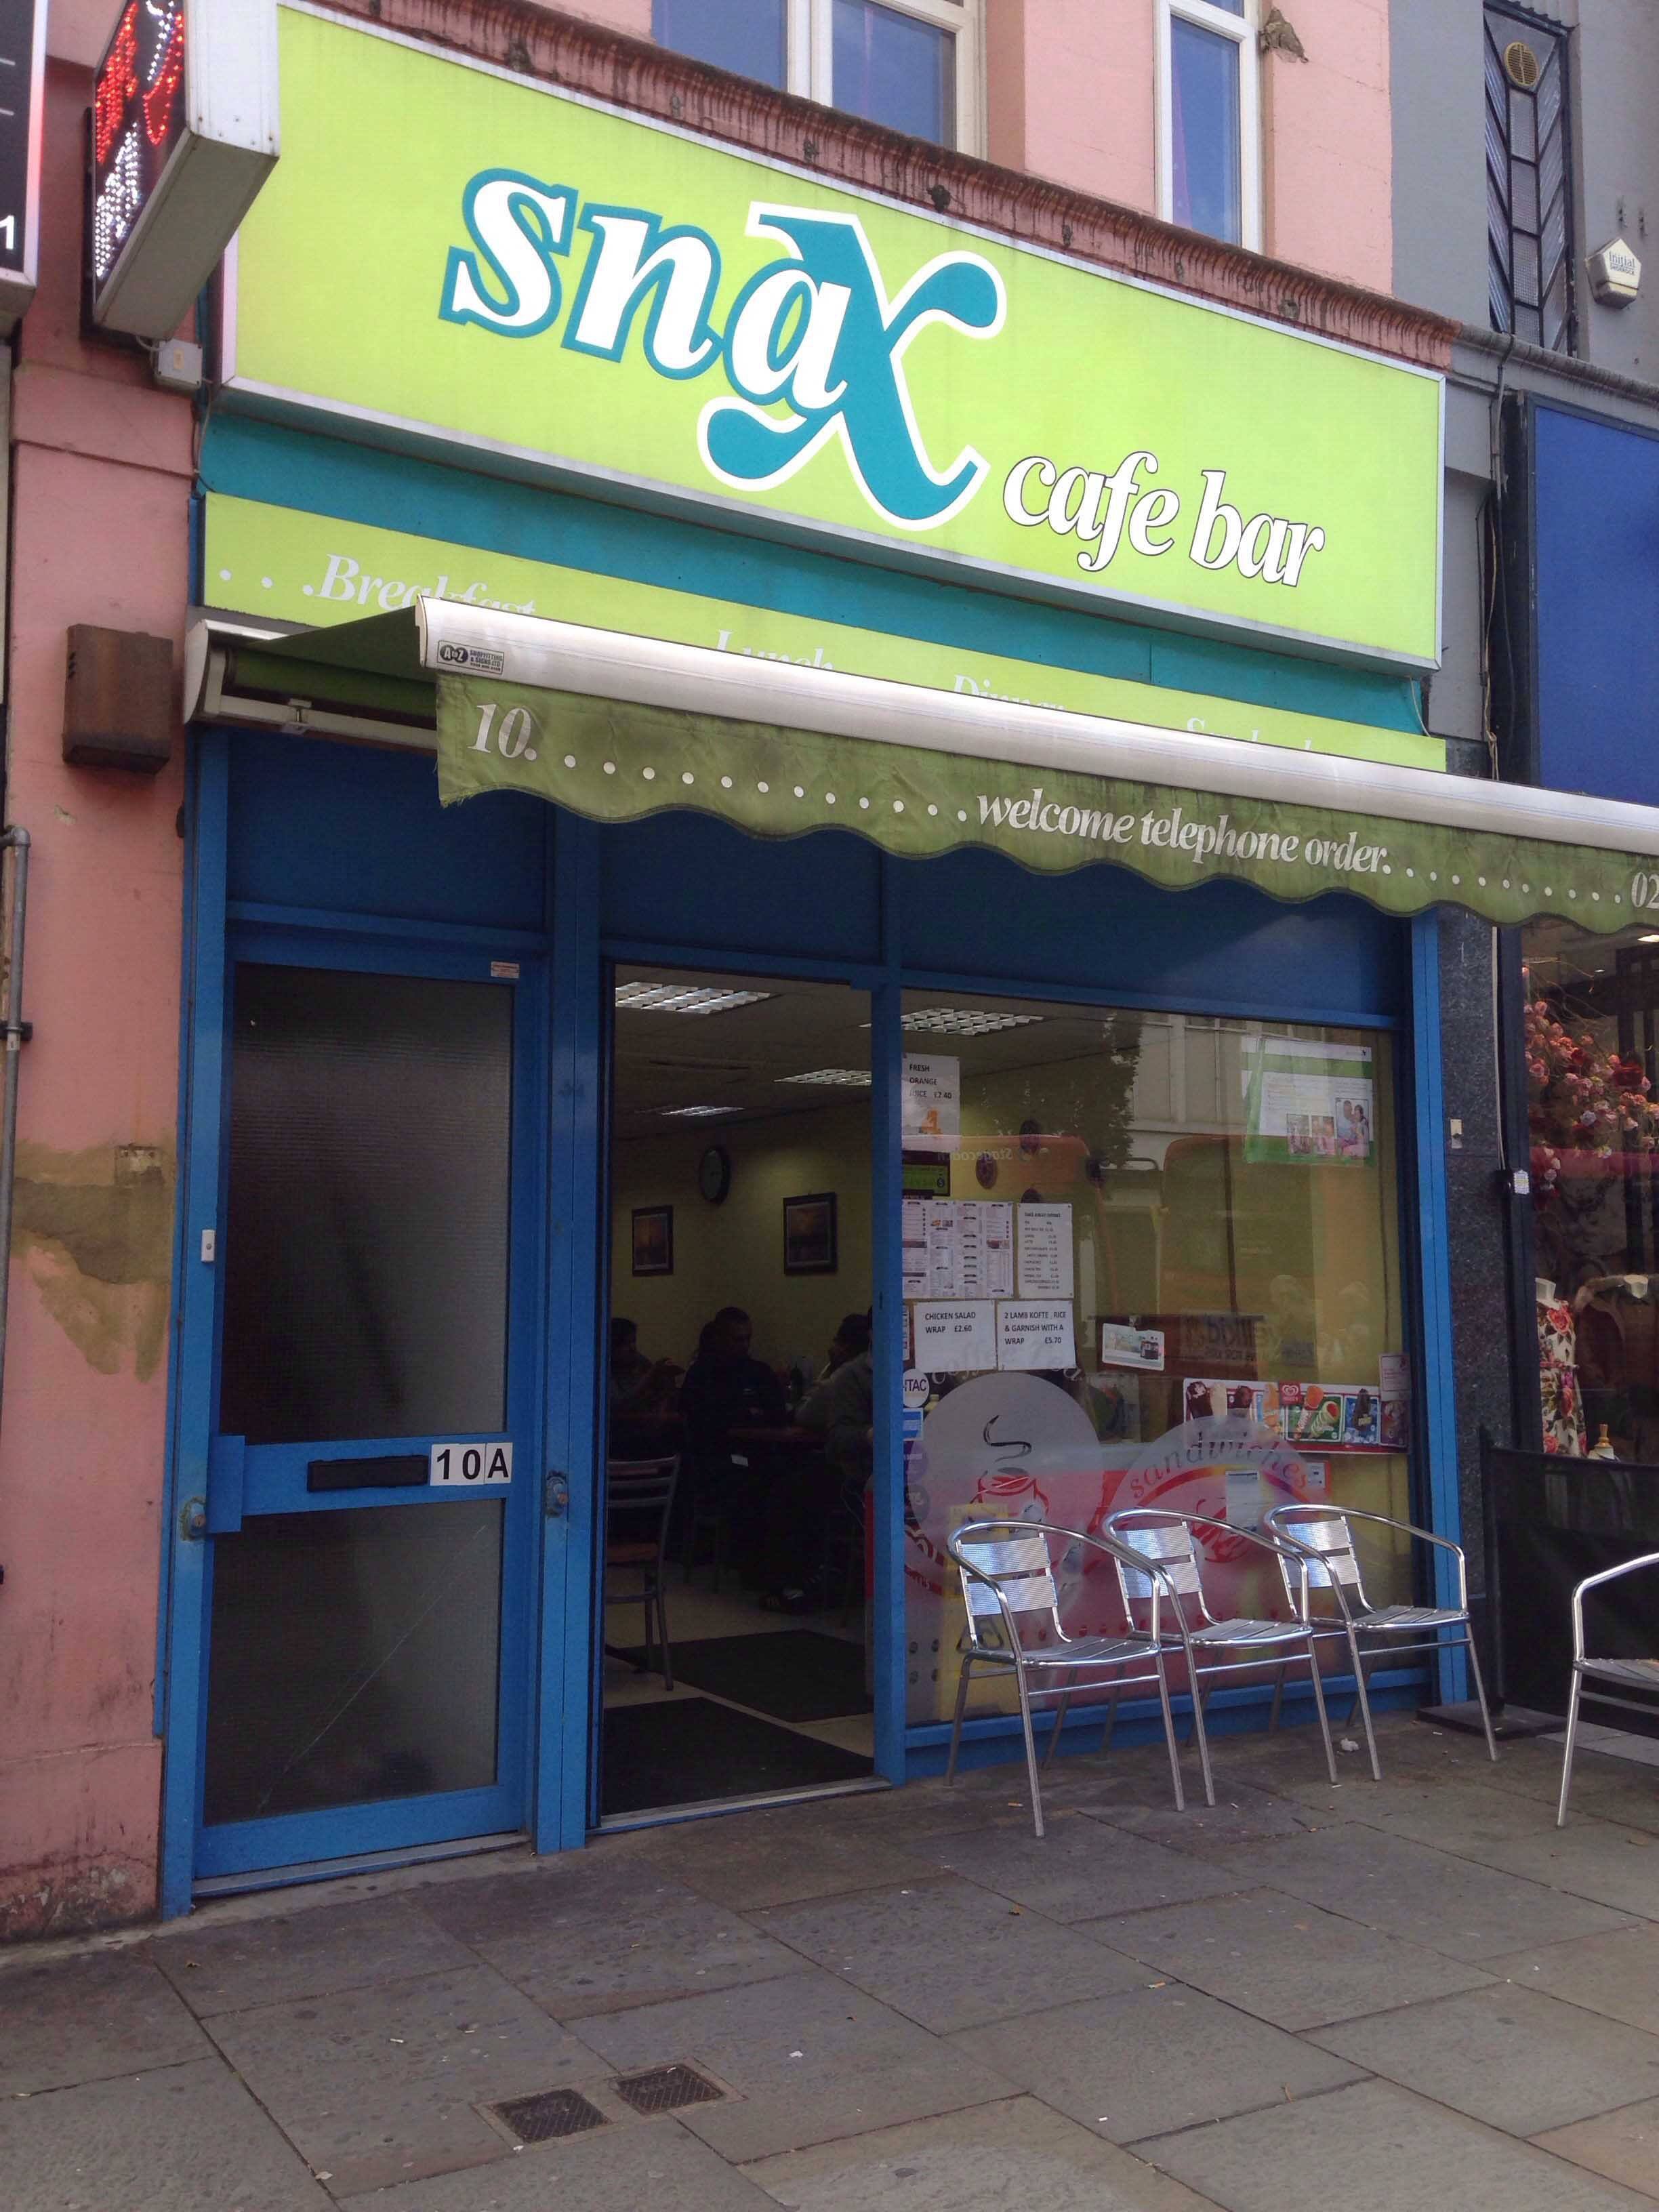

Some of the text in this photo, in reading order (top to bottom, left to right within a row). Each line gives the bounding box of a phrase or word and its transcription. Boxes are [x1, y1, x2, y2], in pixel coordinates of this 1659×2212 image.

[1002, 451, 1326, 587] cafe bar
[977, 787, 1135, 844] welcome
[1140, 807, 1299, 863] telephone
[909, 1063, 930, 1072] FRESH
[909, 1077, 938, 1086] ORANGE
[954, 1311, 976, 1319] SALAD
[925, 1324, 972, 1334] WRAP £2.60
[1011, 1324, 1040, 1332] GARNISH
[1041, 1323, 1058, 1331] WITH
[905, 1379, 926, 1391] TAC
[436, 1448, 510, 1480] 10A
